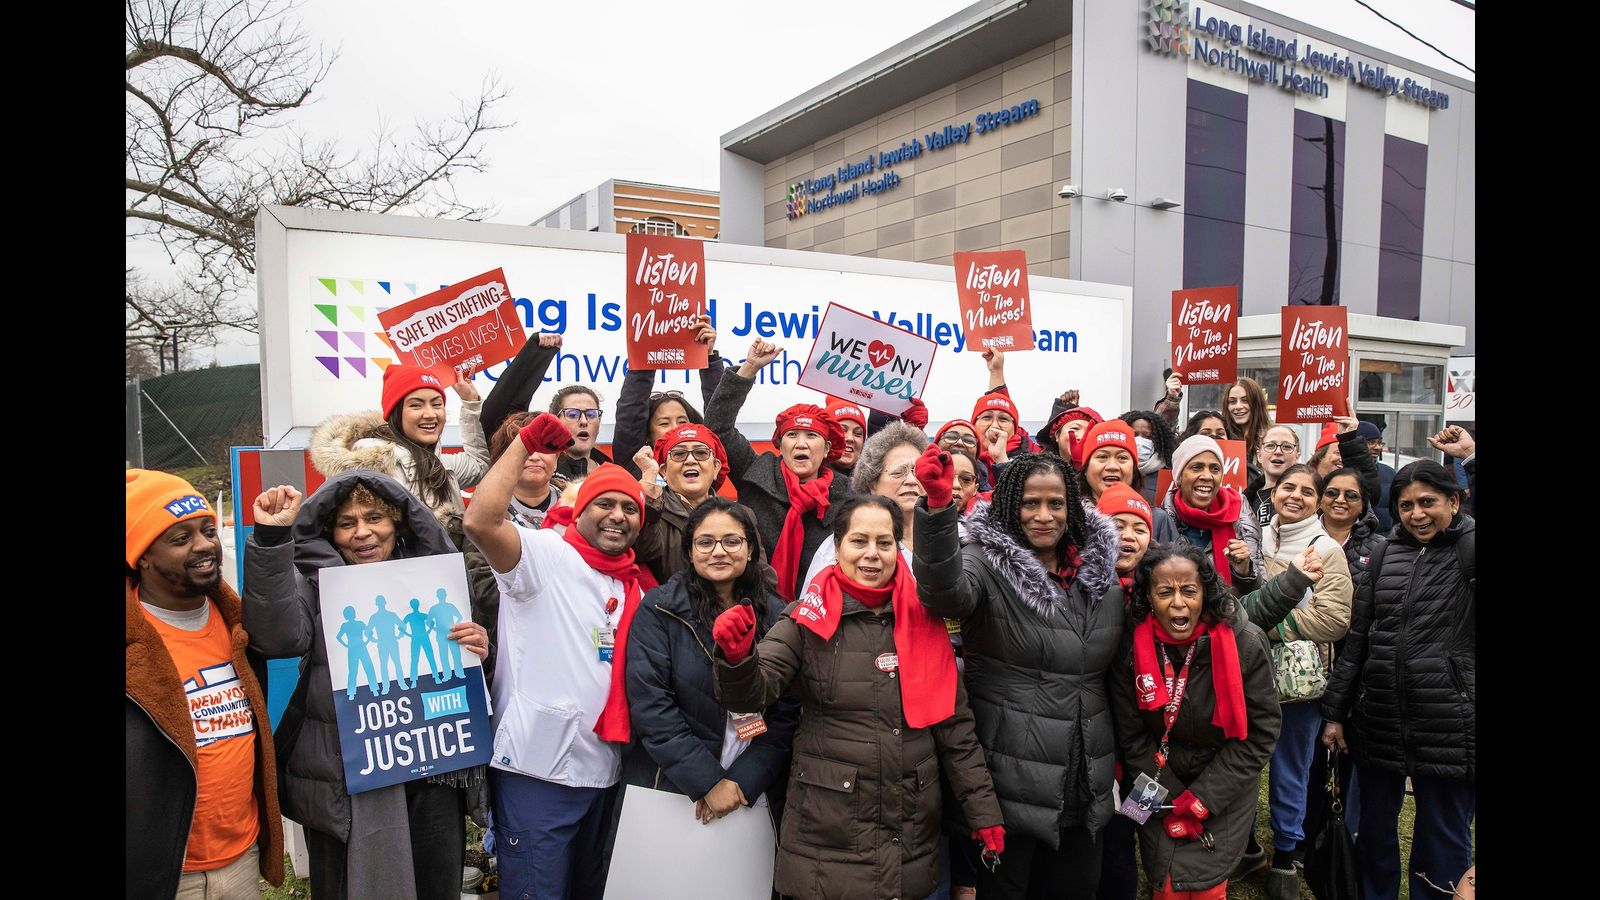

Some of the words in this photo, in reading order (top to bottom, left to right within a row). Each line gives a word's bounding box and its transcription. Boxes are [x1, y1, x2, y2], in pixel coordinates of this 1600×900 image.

[1194, 38, 1277, 85] Northwell
[1282, 65, 1329, 98] Health
[1195, 8, 1242, 45] Long
[1248, 25, 1298, 60] Island
[1302, 44, 1353, 79] Jewish
[1358, 61, 1400, 95] Valley
[1403, 78, 1449, 109] Stream
[807, 173, 834, 195] Long
[838, 156, 873, 183] Island
[876, 138, 921, 170] Jewish
[925, 122, 971, 151] Valley
[975, 98, 1040, 135] Stream
[807, 183, 859, 215] Northwell
[862, 172, 901, 195] Health
[396, 319, 428, 347] SAFE
[426, 311, 448, 333] RN
[445, 287, 501, 323] STAFFING
[731, 302, 819, 339] Jewi
[421, 335, 465, 369] SAVES
[463, 323, 498, 351] LIVES
[647, 351, 685, 360] NURSES
[831, 331, 867, 360] WE
[891, 355, 922, 379] NY
[815, 350, 917, 400] nurses
[169, 497, 208, 515] NYCC
[190, 691, 223, 711] NEW
[223, 686, 246, 701] YO
[194, 698, 250, 718] COMMUNITIES
[354, 696, 413, 734] JOBS
[427, 692, 462, 713] WITH
[195, 709, 252, 733] CHANG
[738, 720, 762, 733] DIABETES
[359, 719, 475, 776] JUSTICE
